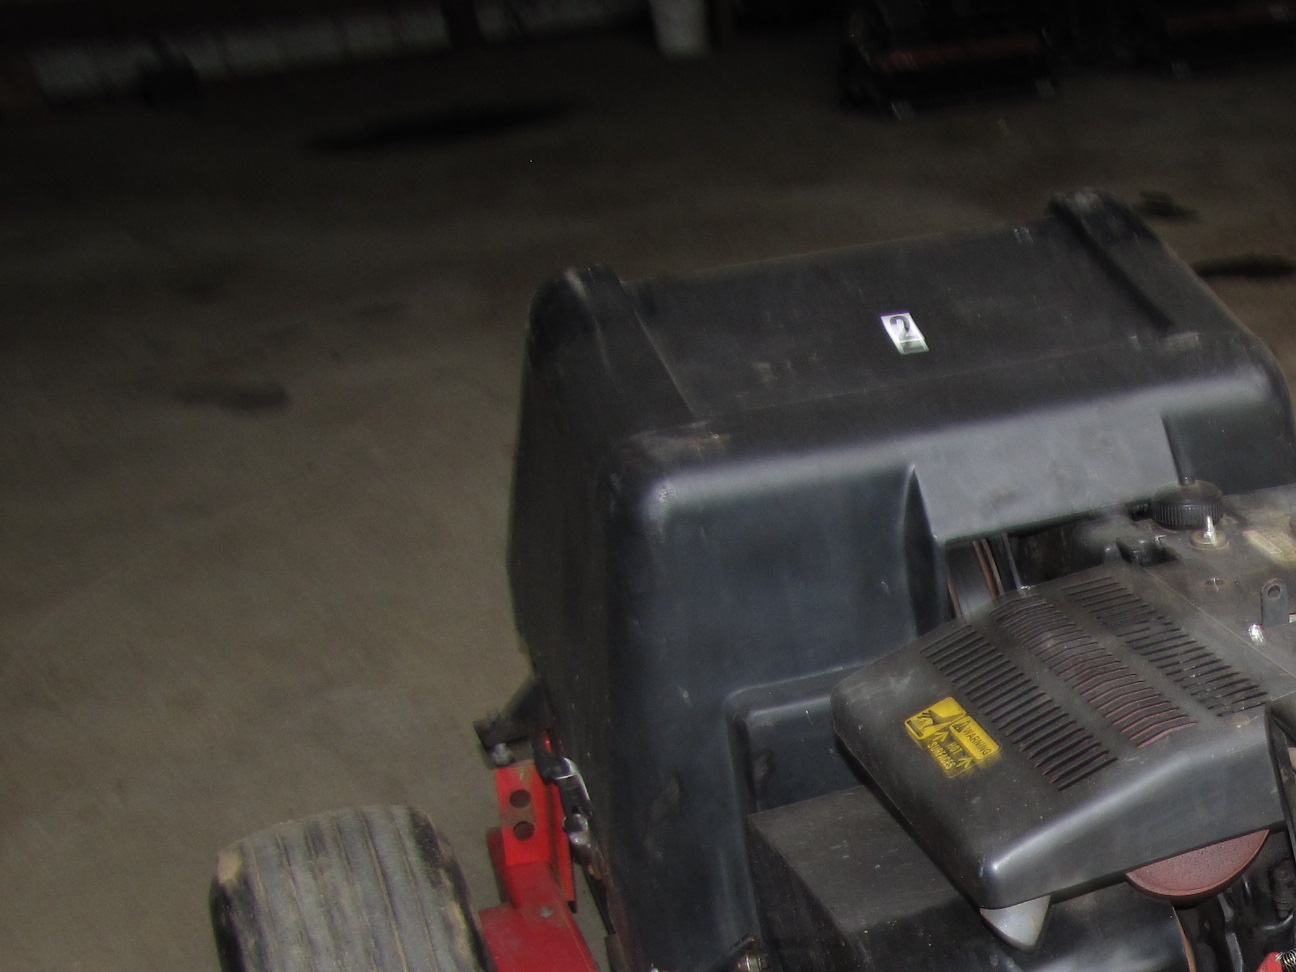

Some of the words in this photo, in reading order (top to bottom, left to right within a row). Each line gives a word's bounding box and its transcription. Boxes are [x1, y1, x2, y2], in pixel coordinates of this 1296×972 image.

[928, 741, 956, 770] SURFACES
[947, 741, 962, 755] HOT
[964, 727, 992, 756] WARNING
